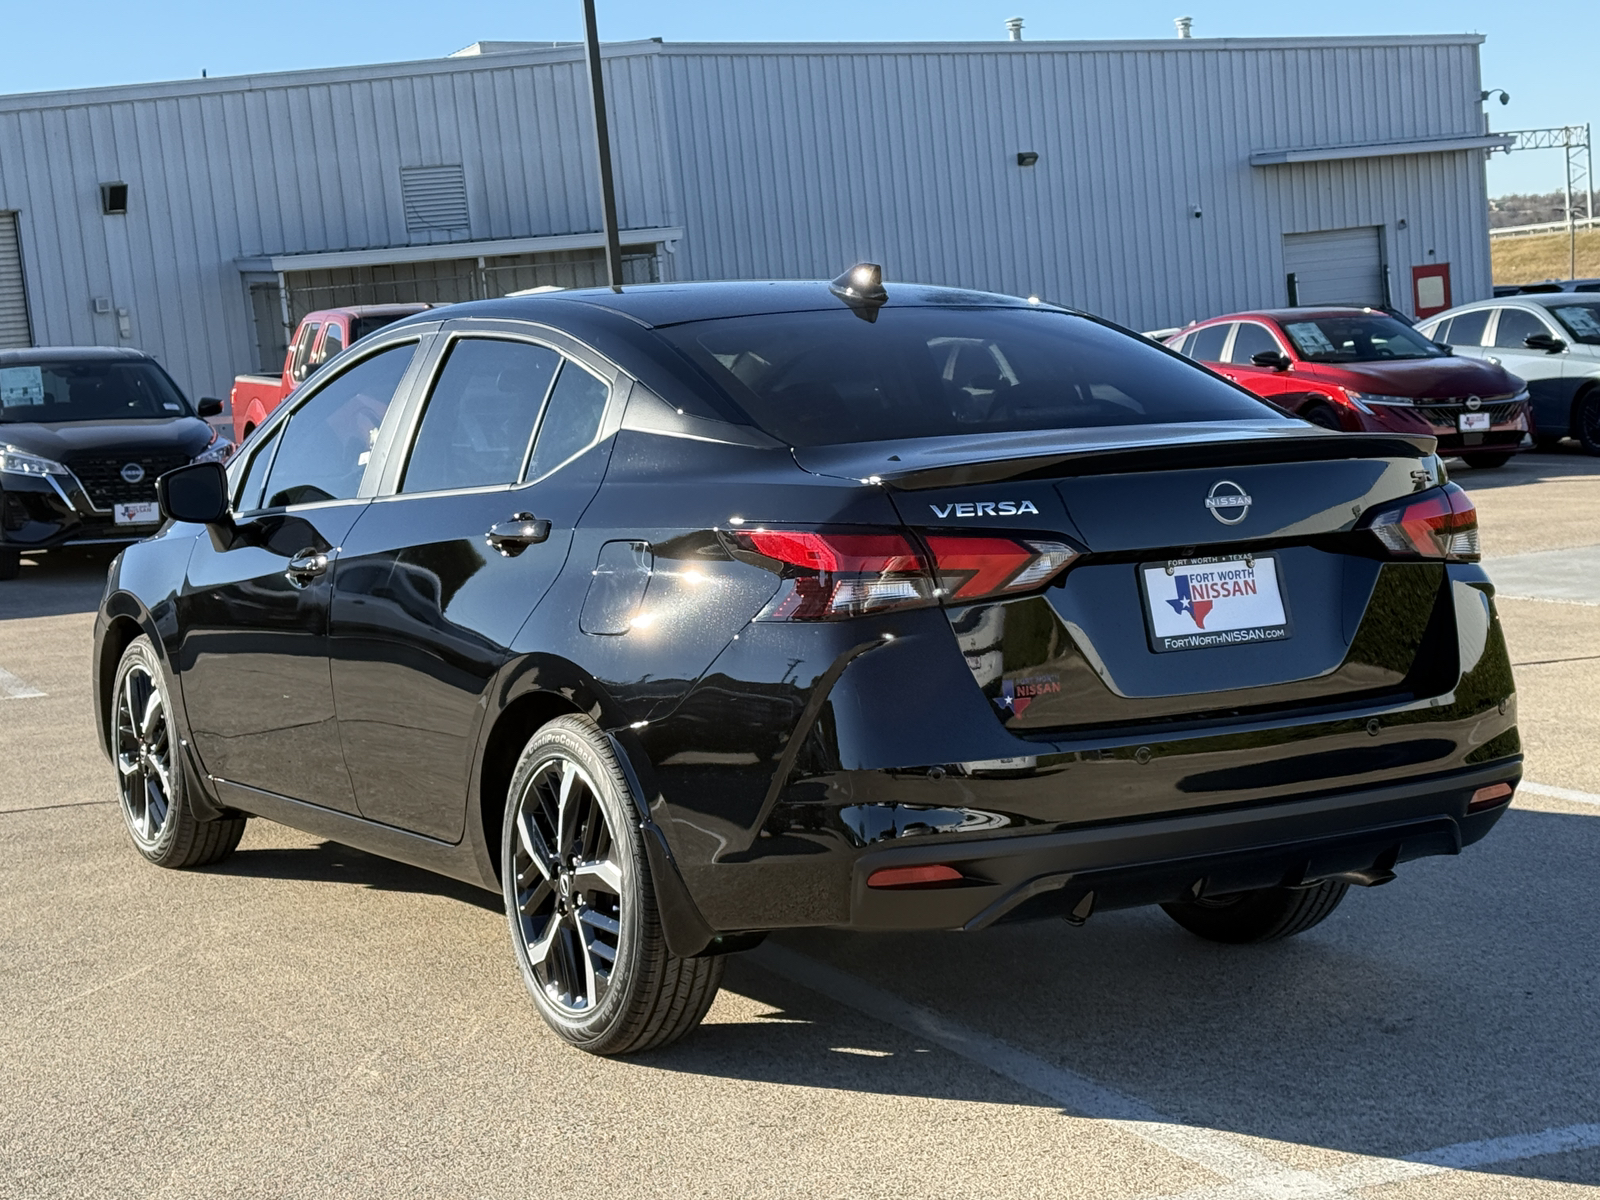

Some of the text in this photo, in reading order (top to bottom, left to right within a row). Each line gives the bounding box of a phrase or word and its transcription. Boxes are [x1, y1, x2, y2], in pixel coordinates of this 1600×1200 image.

[1410, 470, 1432, 483] SR
[1206, 497, 1252, 506] NISSAN
[929, 500, 1039, 519] VERSA
[1167, 553, 1253, 567] FORT WORTH TEXAS
[1189, 569, 1255, 583] FORT WORTH
[1190, 579, 1257, 600] NISSAN
[1016, 682, 1061, 697] NISSAN
[529, 733, 593, 765] ContiProContact
